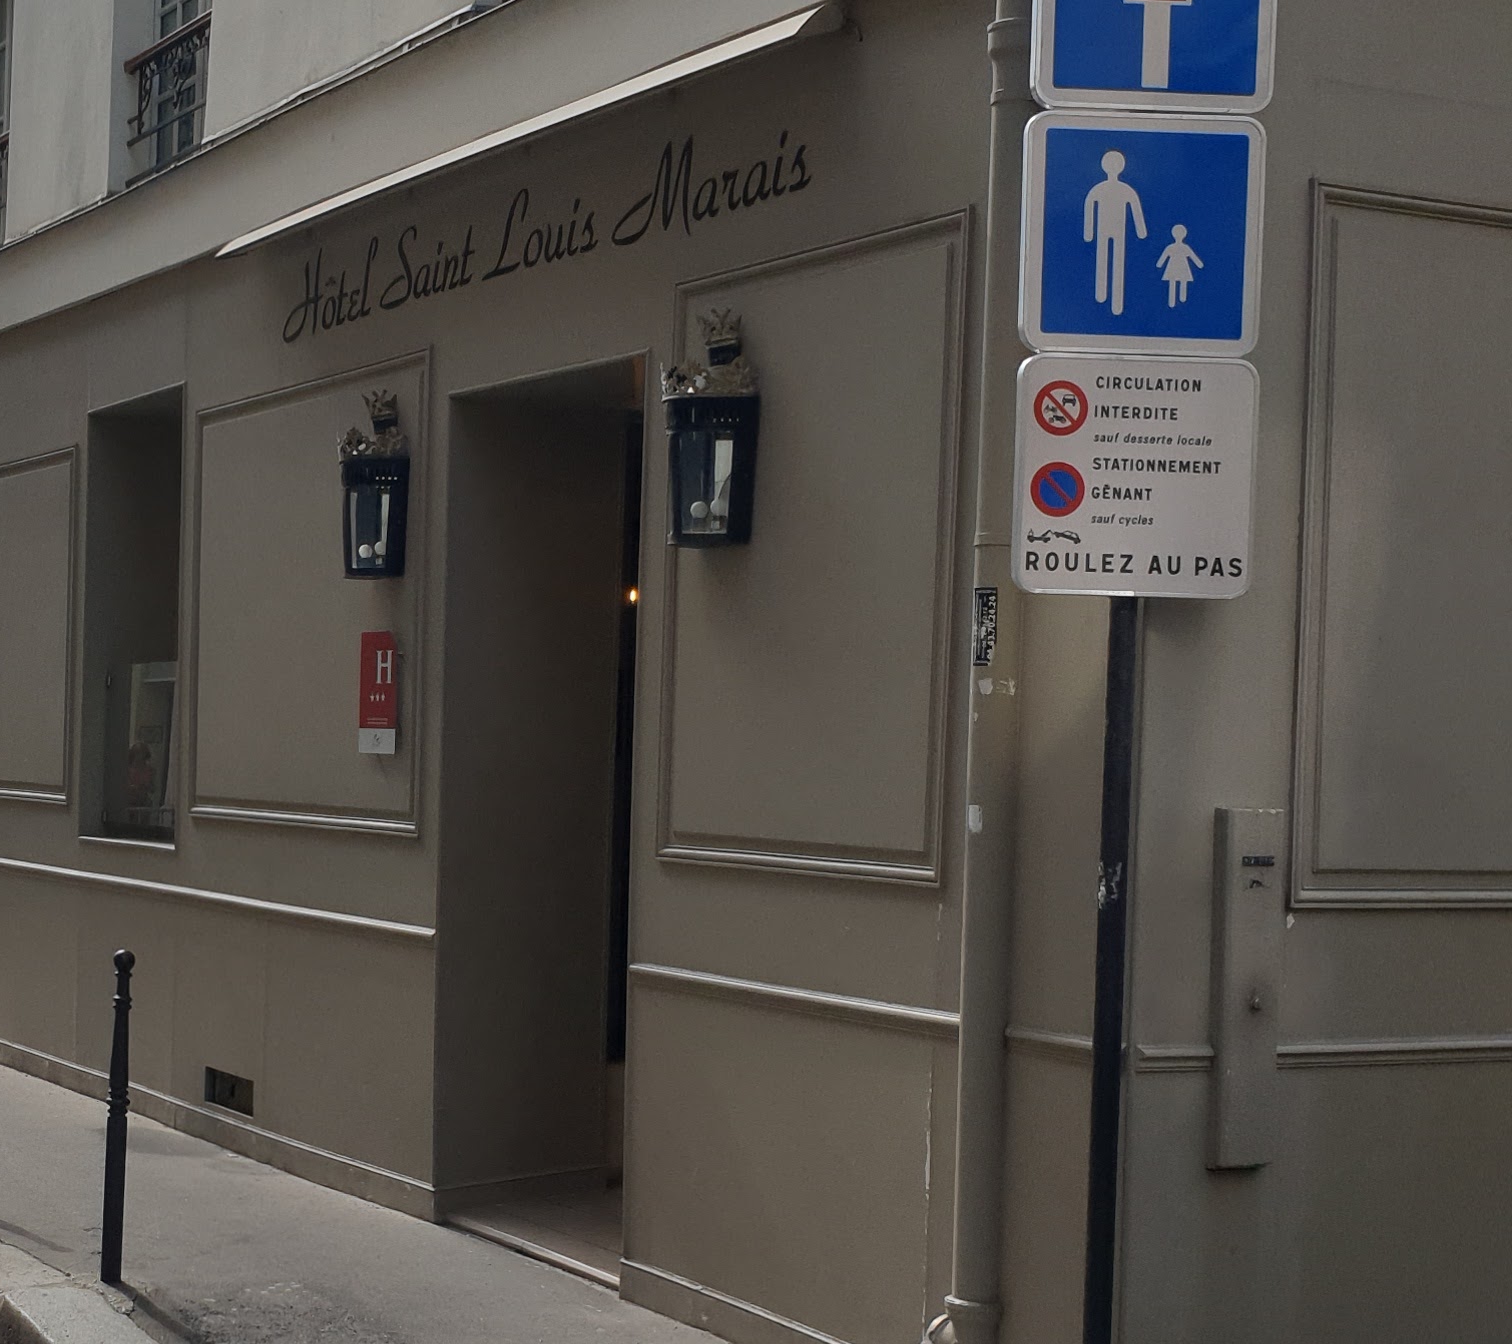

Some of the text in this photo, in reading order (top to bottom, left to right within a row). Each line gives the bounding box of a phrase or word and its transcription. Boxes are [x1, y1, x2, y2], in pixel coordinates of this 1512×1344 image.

[282, 130, 812, 342] Hôtel Saint Louis Marais
[1095, 375, 1202, 393] CIRCULATION
[1093, 405, 1178, 421] INTERDITE
[1093, 432, 1212, 447] sauf desserte locale
[1092, 457, 1222, 474] STATIONNEMENT
[1091, 484, 1153, 501] GÊNANT
[1091, 513, 1154, 527] sauf cycles
[1025, 551, 1243, 578] ROULEZ AU PAS
[376, 650, 394, 684] H
